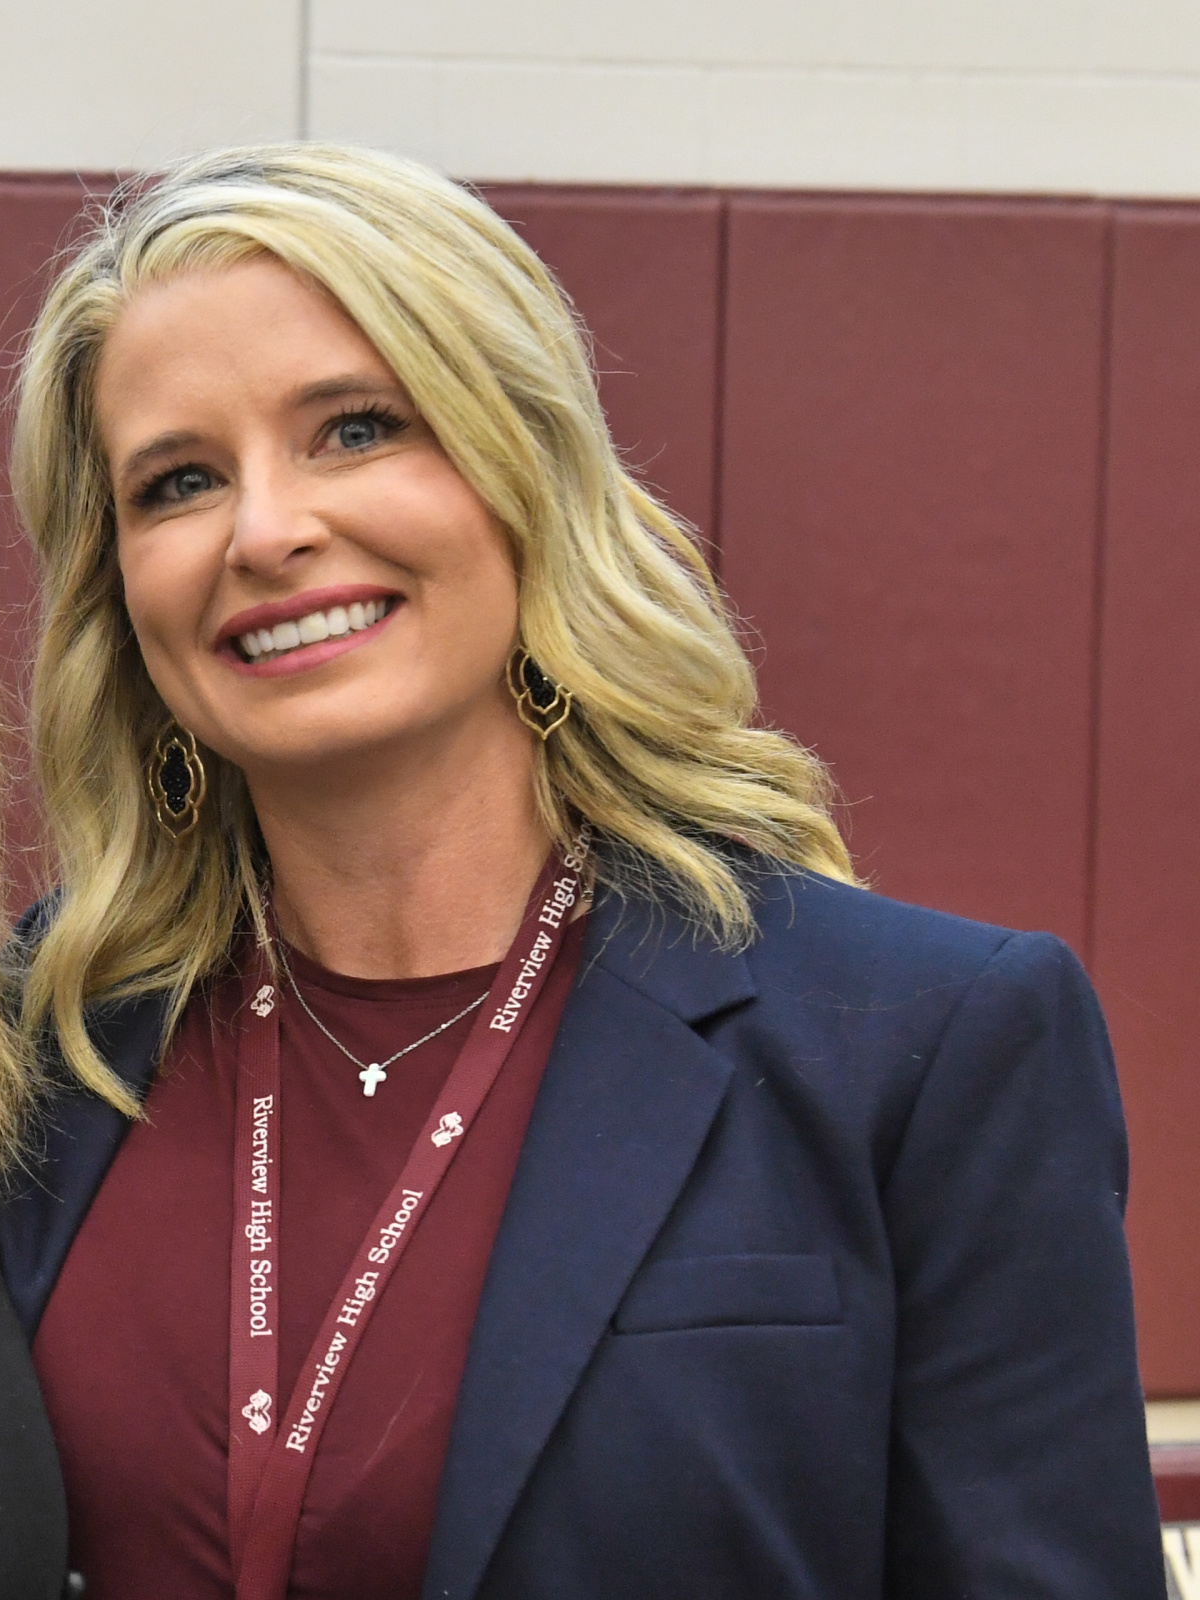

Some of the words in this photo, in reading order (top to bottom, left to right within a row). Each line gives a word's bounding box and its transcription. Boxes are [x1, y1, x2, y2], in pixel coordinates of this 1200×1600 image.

[489, 930, 553, 1033] Riverview
[538, 876, 577, 929] High
[250, 1094, 274, 1194] Riverview
[245, 1200, 272, 1252] High
[250, 1260, 273, 1338] School
[285, 1331, 347, 1454] Riverview
[337, 1271, 379, 1326] High
[368, 1189, 424, 1264] School
